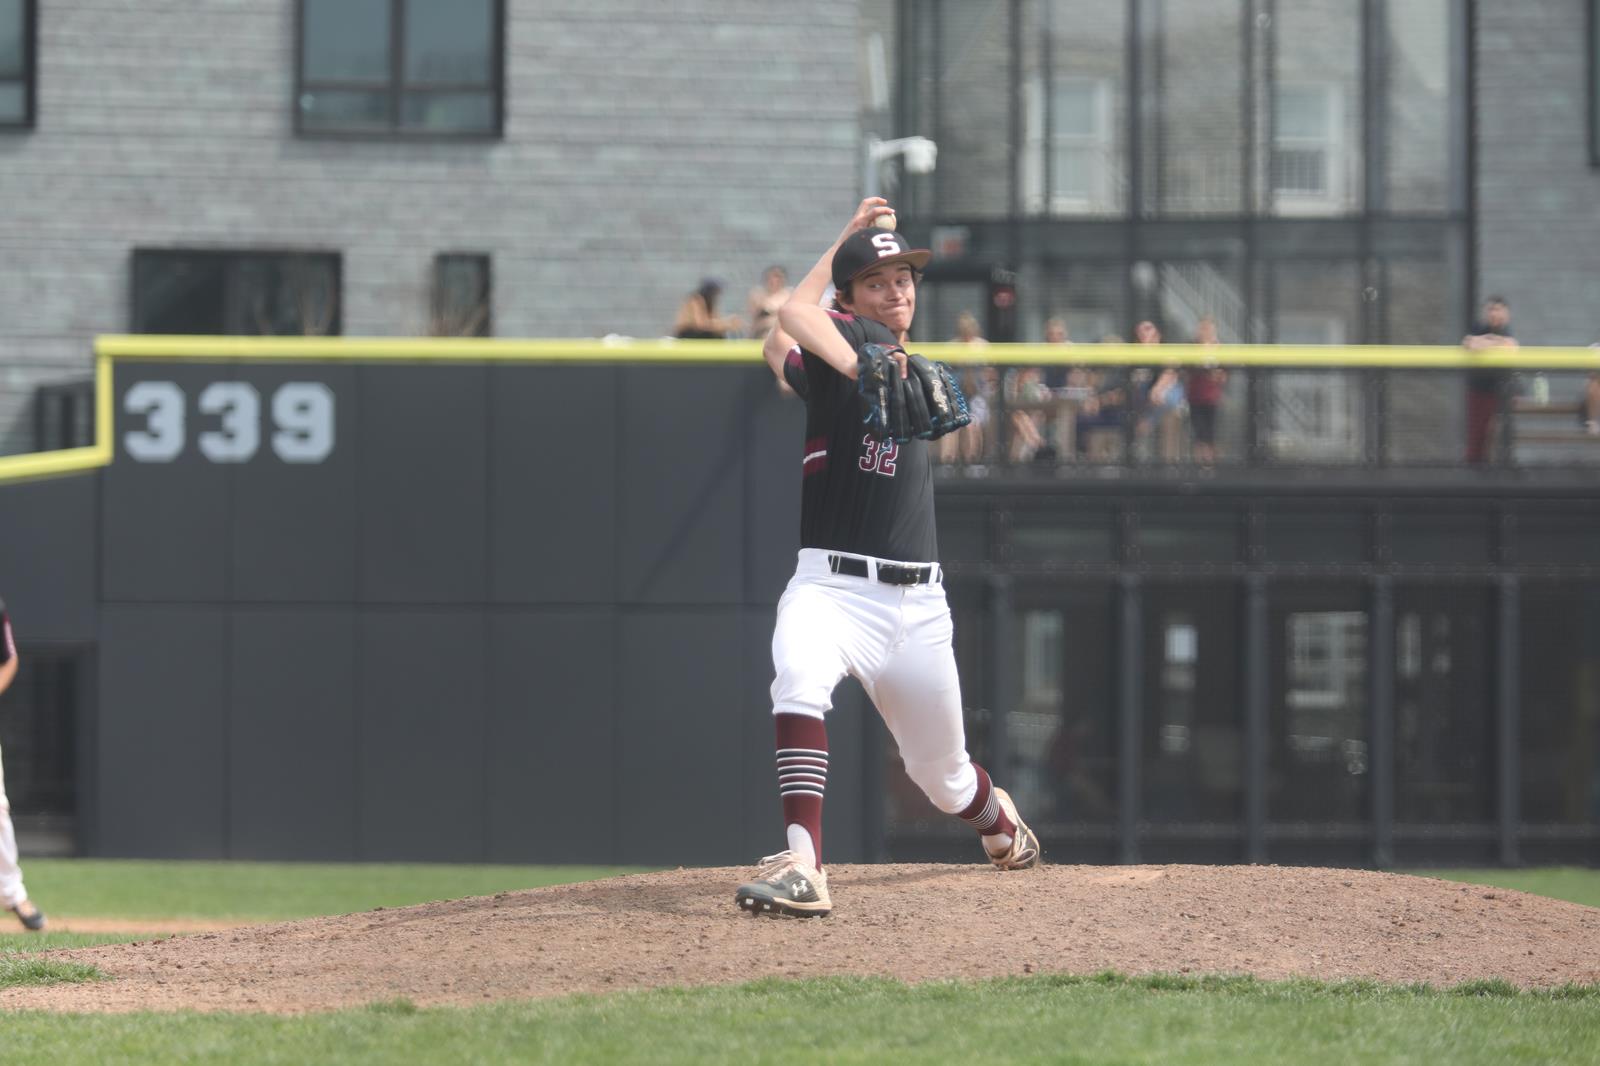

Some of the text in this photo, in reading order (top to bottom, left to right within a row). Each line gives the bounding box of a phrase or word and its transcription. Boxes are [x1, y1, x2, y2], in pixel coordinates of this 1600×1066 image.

[871, 233, 900, 258] S
[124, 381, 335, 464] 339
[859, 432, 898, 476] 32
